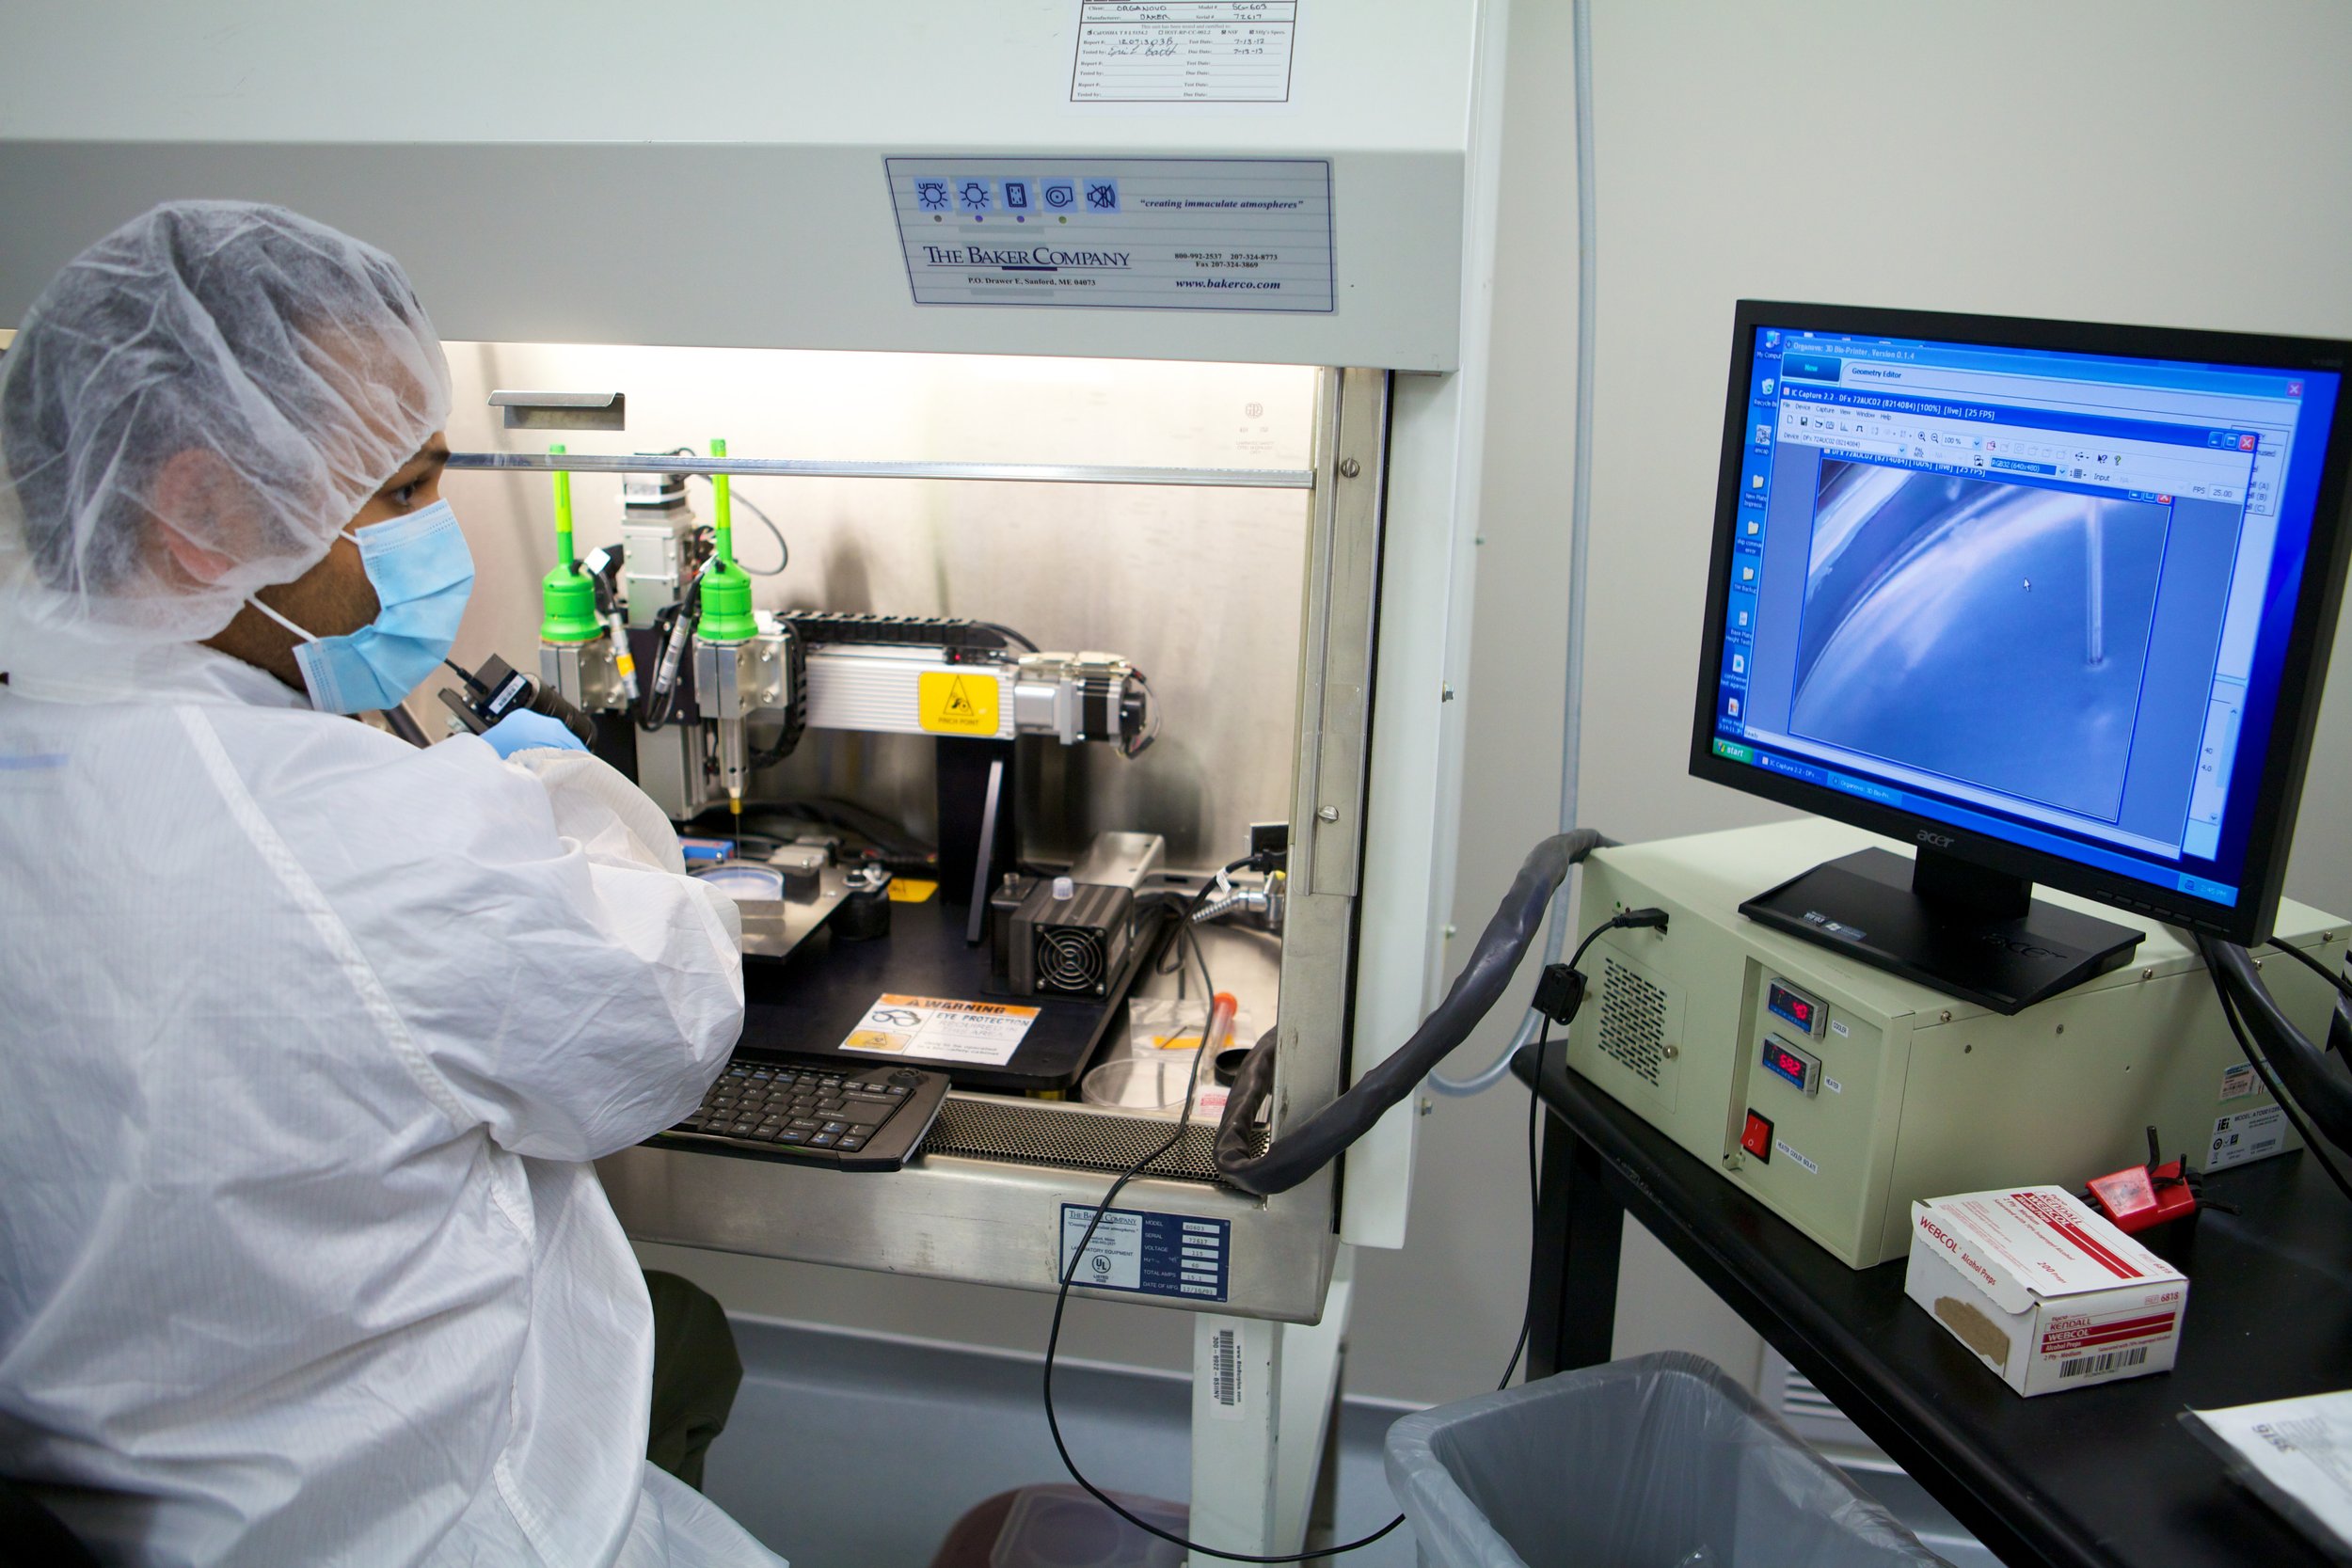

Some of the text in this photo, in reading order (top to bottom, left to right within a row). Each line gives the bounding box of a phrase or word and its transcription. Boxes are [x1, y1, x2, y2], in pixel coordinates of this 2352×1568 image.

[1184, 199, 1237, 209] immaculate
[1240, 200, 1304, 211] atmospheres”
[923, 245, 1131, 266] THE BAKER COMPANY
[1174, 252, 1223, 261] 800-992-2537
[968, 277, 983, 285] P.O.
[1175, 278, 1280, 290] www.bakerco.com
[1872, 349, 1896, 358] Version
[1896, 350, 1915, 360] 0.1.4
[1804, 364, 1819, 372] New
[1851, 368, 1902, 379] Geometry Editor
[1754, 399, 1772, 407] Recycle
[1799, 389, 1822, 401] Capture
[1882, 400, 1916, 412] (8214084)
[1916, 403, 1942, 414] [100%]
[1944, 405, 1963, 418] [live]
[1964, 407, 1978, 419] [25
[1979, 410, 1995, 421] FPS]
[1795, 403, 1811, 411] Device
[1816, 404, 1835, 414] Capture
[1856, 410, 1876, 419] Window
[1784, 432, 1799, 440] Device
[2094, 473, 2110, 482] Input
[2192, 485, 2233, 499] FPS 25.00
[938, 717, 979, 726] PINCH POINT
[1727, 746, 1744, 757] start
[1916, 829, 1954, 847] acer
[924, 999, 1006, 1014] WARNING
[936, 1012, 1031, 1026] EYE PROTECTION
[1833, 1021, 1848, 1034] COOLER
[1825, 1077, 1839, 1090] HEATER
[1777, 1141, 1790, 1153] HEATER
[1789, 1149, 1803, 1162] COOLER
[2017, 1196, 2038, 1214] Alcohol
[2027, 1195, 2071, 1227] WEBCOL
[2040, 1194, 2083, 1226] KENDALL
[1069, 1210, 1137, 1225] THE COMPANY
[2019, 1209, 2041, 1226] Medium
[1919, 1215, 1958, 1254] WEBCOL
[1994, 1198, 2015, 1216] Saturated
[2034, 1228, 2058, 1249] Isopropyl
[2056, 1244, 2075, 1260] Alcohol
[1096, 1259, 1107, 1270] UL
[1962, 1253, 1997, 1286] Alcohol Preps
[2037, 1260, 2068, 1284] 200 Preps
[2160, 1291, 2179, 1303] 6818
[2050, 1318, 2091, 1331] KENDALL
[2048, 1328, 2090, 1341] WEBCOL
[2045, 1340, 2082, 1352] Alcohol Preps
[2060, 1350, 2082, 1358] Medium
